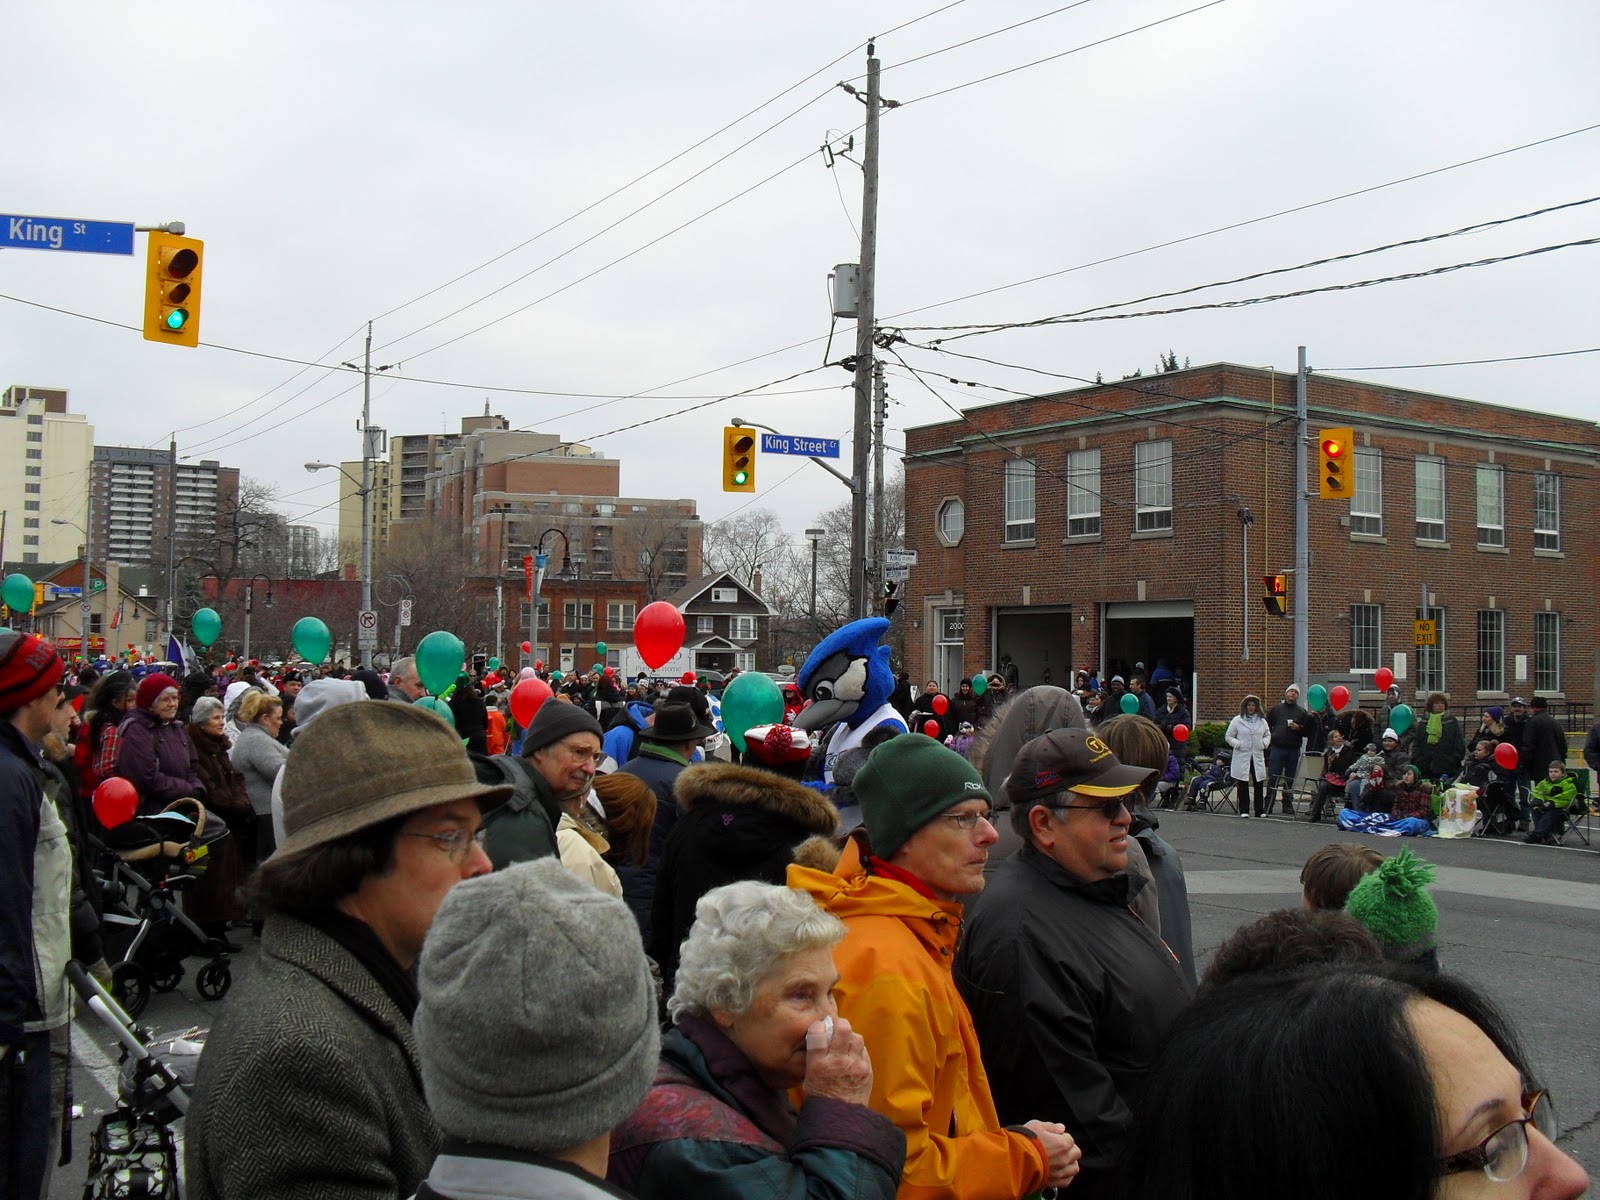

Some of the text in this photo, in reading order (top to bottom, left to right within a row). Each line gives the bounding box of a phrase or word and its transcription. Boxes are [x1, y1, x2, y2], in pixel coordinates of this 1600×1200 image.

[9, 217, 86, 249] King St
[765, 435, 837, 454] King Street Cr
[1419, 623, 1430, 631] NO
[1416, 633, 1433, 642] EXIT
